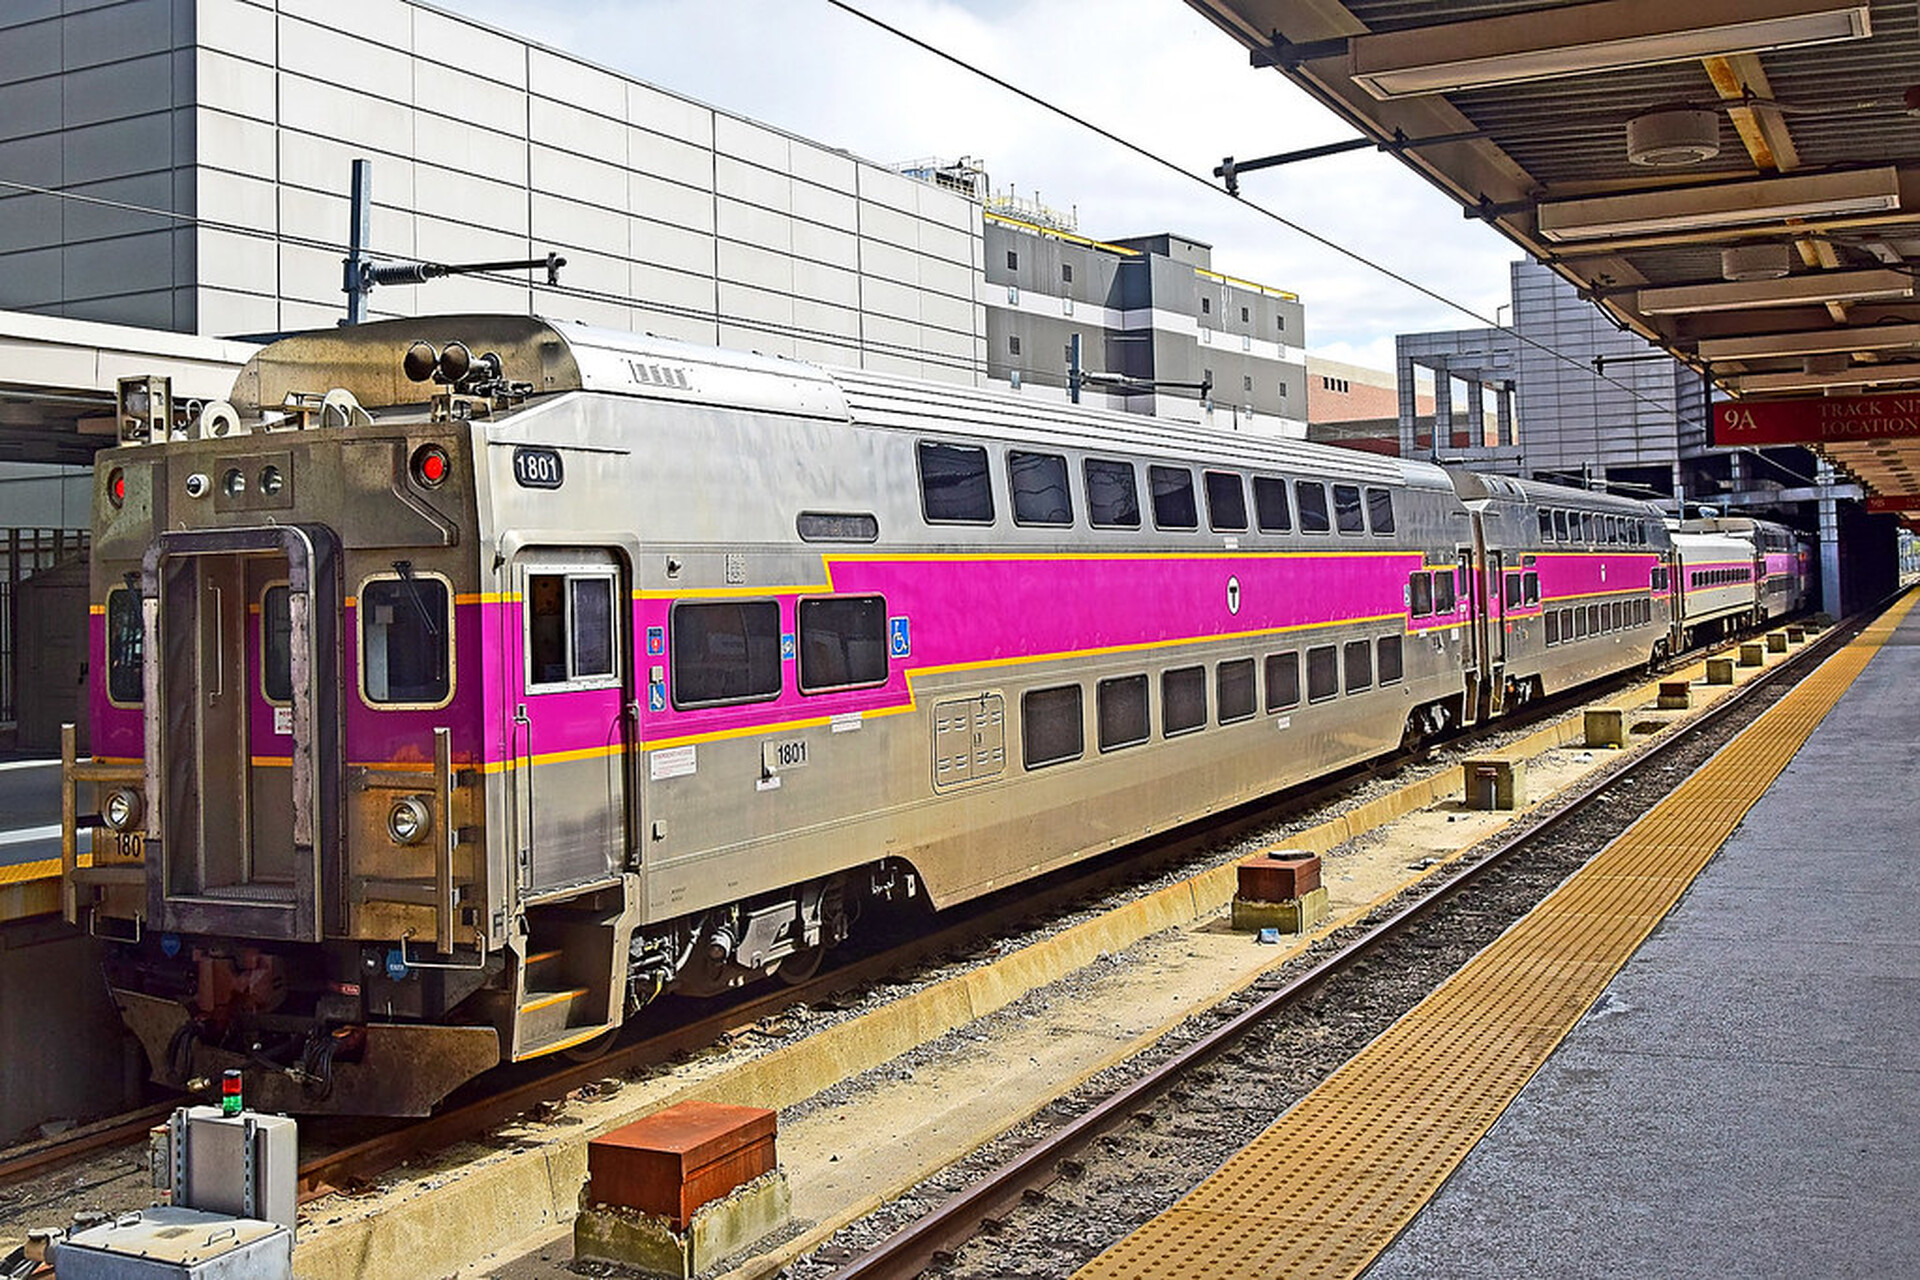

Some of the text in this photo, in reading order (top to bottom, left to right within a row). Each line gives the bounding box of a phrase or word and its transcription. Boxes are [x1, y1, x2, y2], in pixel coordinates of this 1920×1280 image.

[1724, 409, 1757, 430] 9A
[1818, 402, 1882, 417] TRACK
[1821, 416, 1919, 435] LOCATION
[517, 455, 557, 481] 1801
[778, 742, 806, 765] 1801
[114, 833, 141, 857] 180
